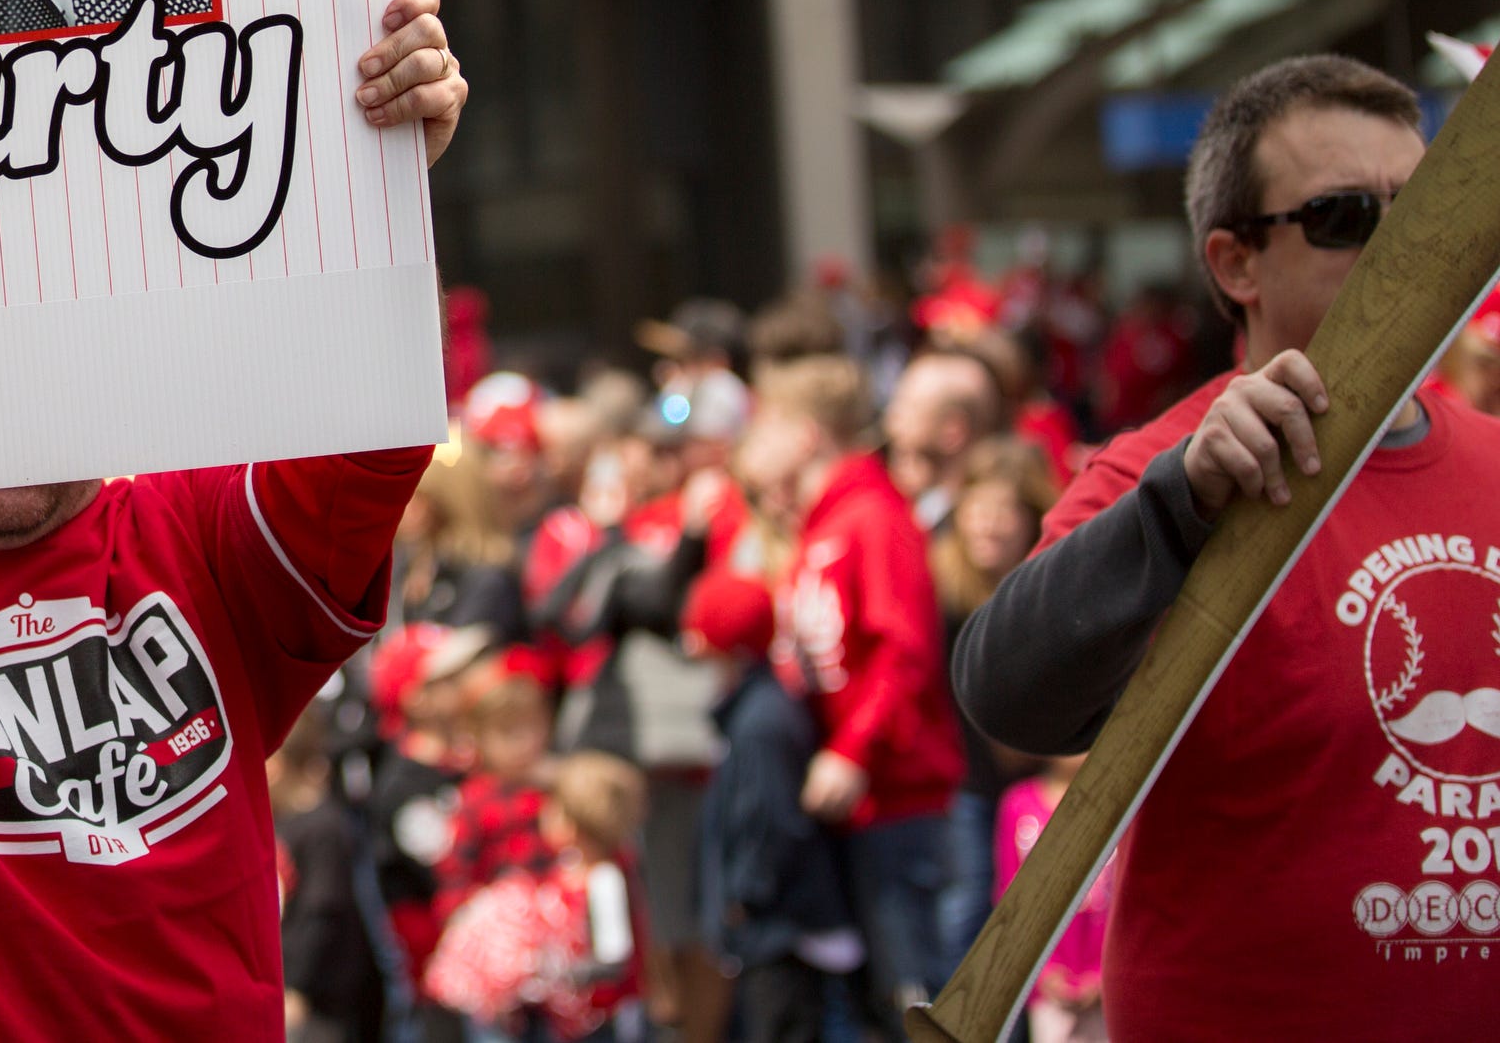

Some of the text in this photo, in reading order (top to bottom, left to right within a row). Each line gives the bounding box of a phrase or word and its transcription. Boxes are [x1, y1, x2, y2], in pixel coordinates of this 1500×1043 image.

[1335, 533, 1476, 627] OPENING
[10, 612, 56, 639] The
[167, 717, 211, 758] 1936
[14, 740, 168, 826] Café
